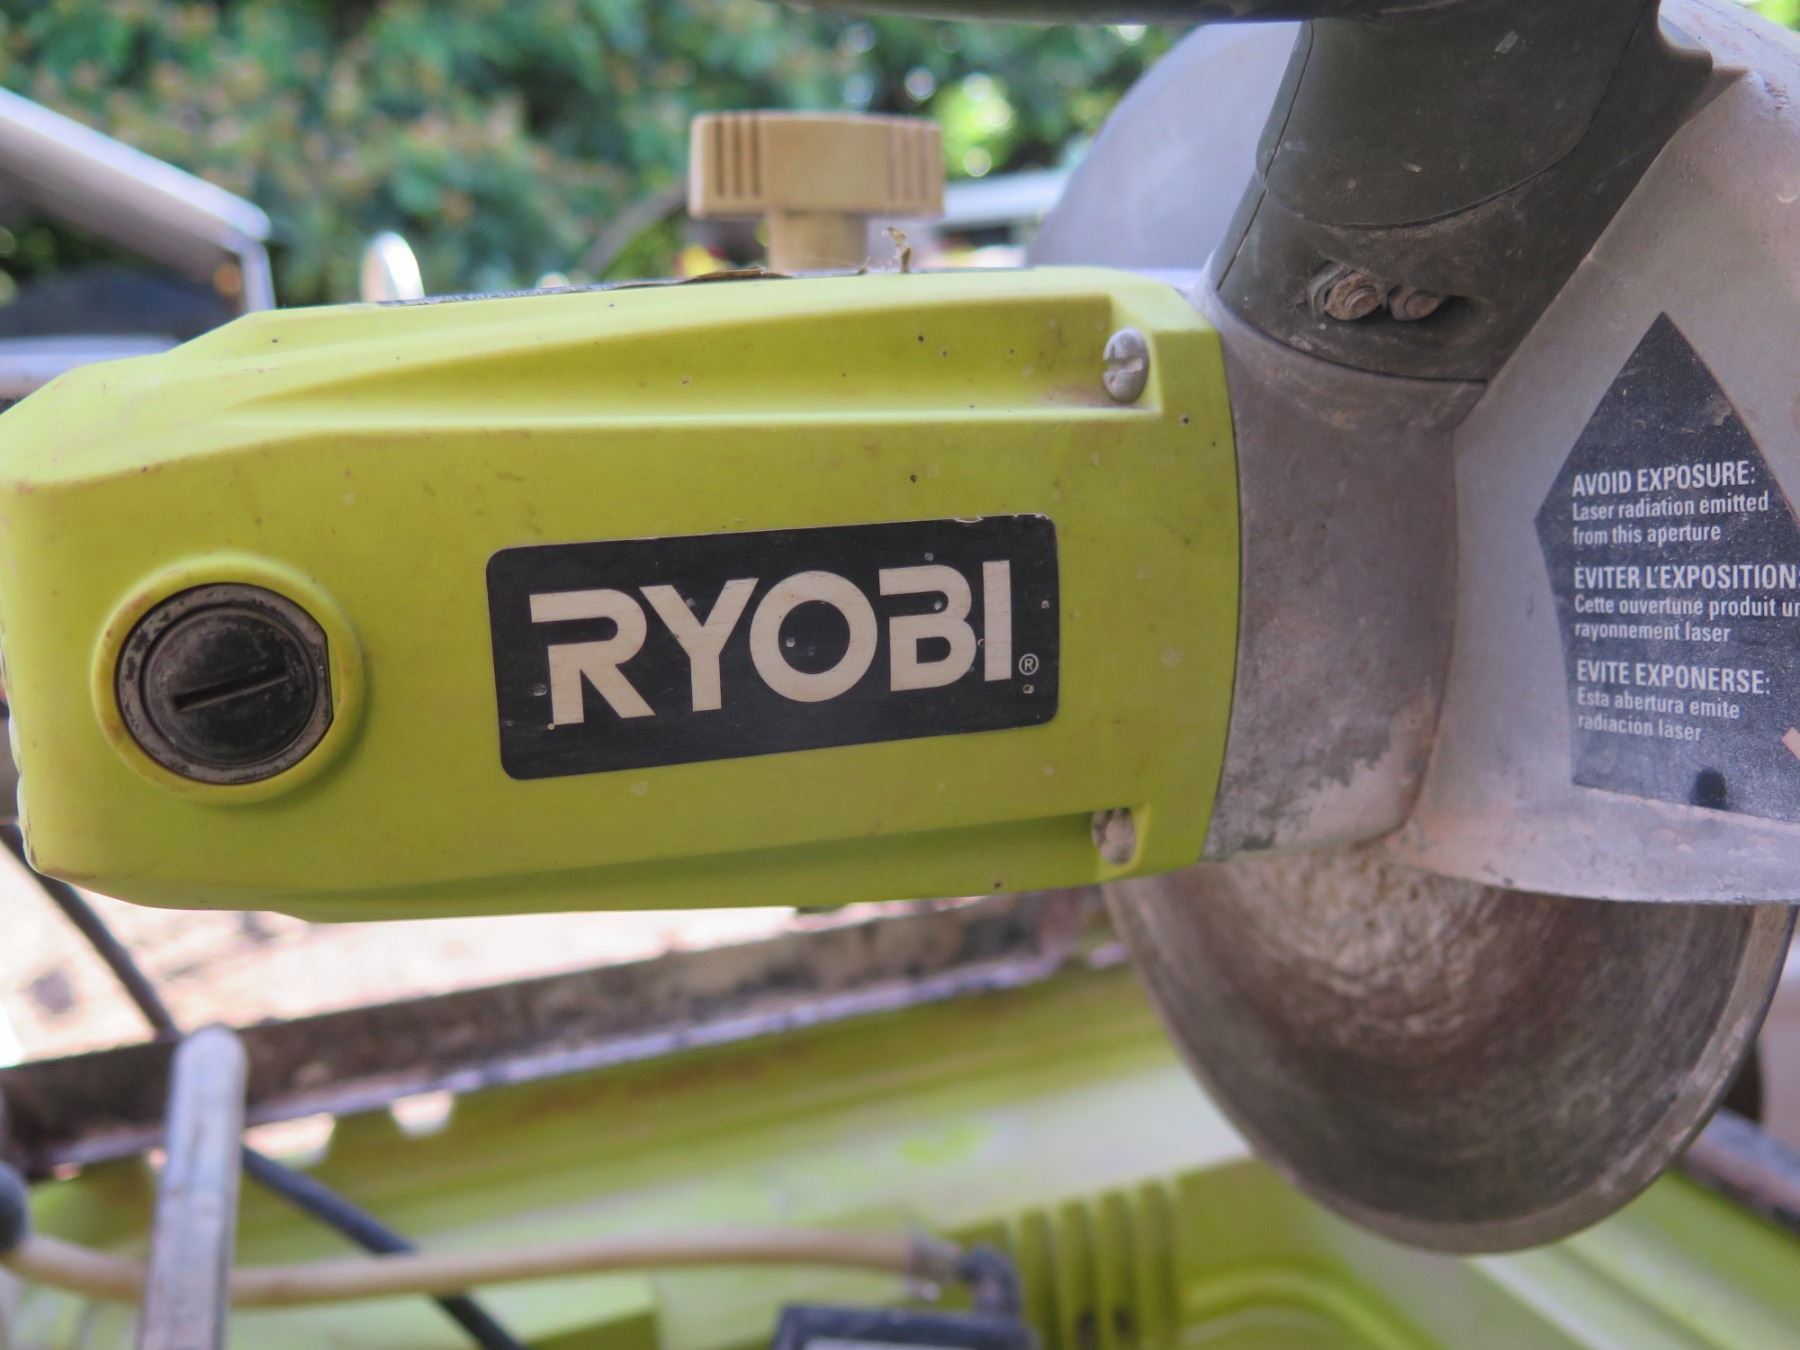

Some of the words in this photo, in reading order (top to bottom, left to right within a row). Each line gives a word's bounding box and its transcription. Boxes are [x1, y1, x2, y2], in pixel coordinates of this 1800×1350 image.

[1572, 470, 1632, 497] AVOID
[1637, 460, 1756, 492] EXPOSURE:
[1572, 502, 1614, 521] Laser
[1618, 497, 1695, 518] radiation
[1699, 490, 1769, 514] emitted
[1573, 526, 1608, 545] from
[1612, 524, 1643, 543] this
[1647, 525, 1722, 547] aperture
[1575, 594, 1614, 613] Cette
[1709, 596, 1776, 620] produit
[529, 559, 1012, 727] RYOBI
[1575, 622, 1680, 642] rayonnement
[1685, 621, 1732, 642] laser
[1577, 660, 1630, 685] EVITE
[1635, 663, 1771, 695] EXPONERSE:
[1577, 687, 1610, 707] Esta
[1614, 690, 1684, 714] abertura
[1689, 698, 1741, 719] emite
